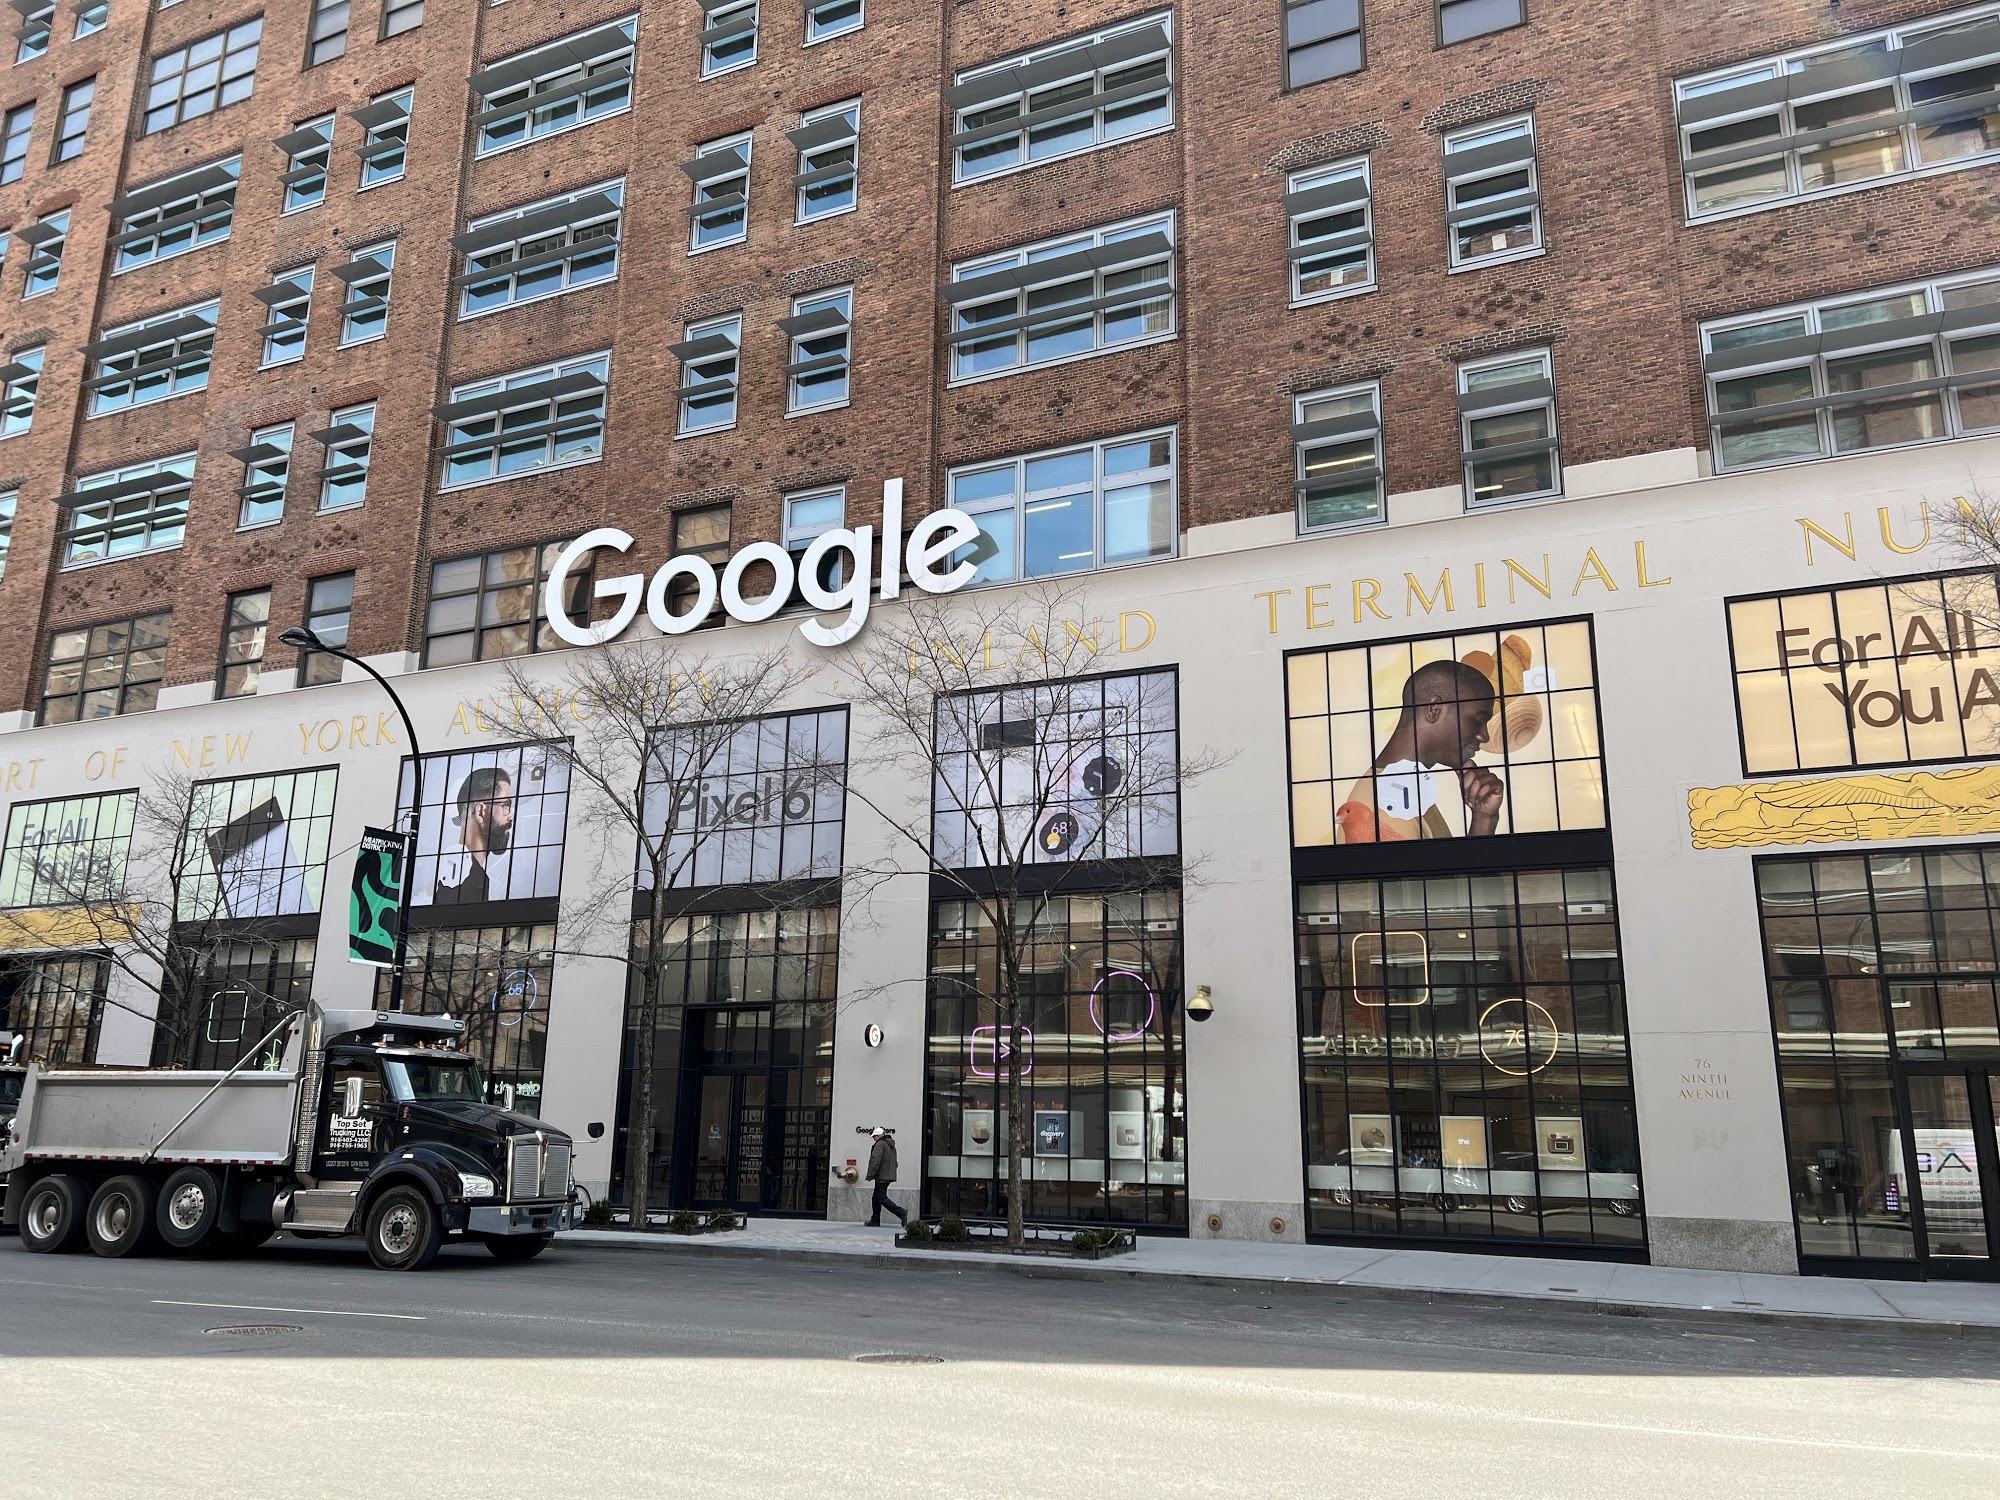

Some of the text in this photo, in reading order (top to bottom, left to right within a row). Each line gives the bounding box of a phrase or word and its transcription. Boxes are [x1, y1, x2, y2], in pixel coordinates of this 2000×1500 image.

[544, 476, 982, 648] Google
[1777, 609, 1979, 677] For All
[0, 758, 45, 792] RT
[84, 746, 128, 782] OF
[172, 729, 254, 769] NEW
[298, 710, 399, 755] YORK
[909, 609, 1158, 680] INLAND
[1253, 540, 1673, 635] TERMINAL
[1822, 678, 1944, 730] You
[673, 775, 811, 830] Pixel 6
[22, 817, 89, 851] For All
[1694, 1059, 1711, 1069] 76
[1681, 1074, 1727, 1084] NINTH
[1679, 1089, 1734, 1100] AVENUE
[337, 1120, 367, 1128] Top Set
[330, 1129, 356, 1138] Trucking
[403, 1125, 409, 1134] 2
[856, 1126, 876, 1135] Googl
[1040, 1130, 1064, 1138] discovery
